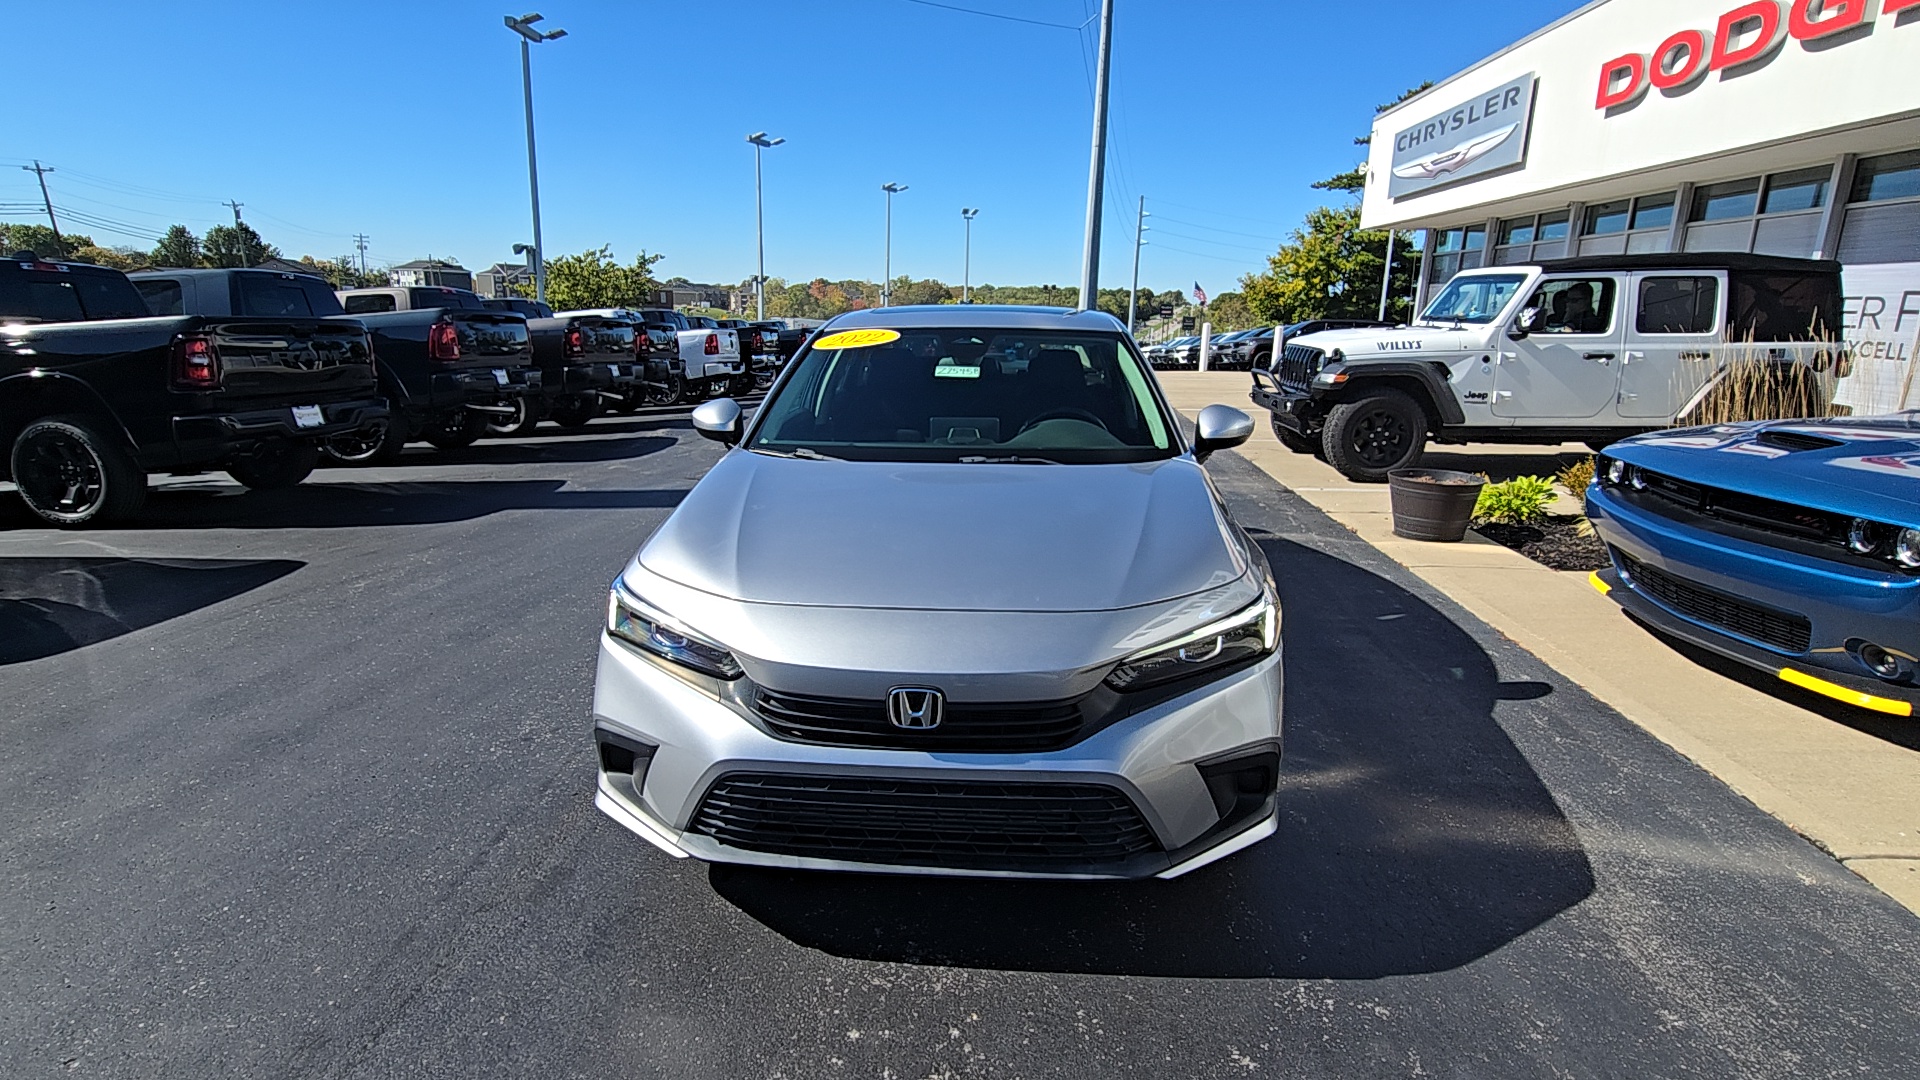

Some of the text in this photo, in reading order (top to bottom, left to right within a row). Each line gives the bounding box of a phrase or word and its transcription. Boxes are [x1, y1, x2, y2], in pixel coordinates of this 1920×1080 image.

[1595, 0, 1920, 110] DODG
[1396, 85, 1521, 152] CHRYSLER
[1841, 290, 1920, 332] ER F
[827, 332, 886, 346] 2022
[1376, 340, 1422, 351] WILLYS
[271, 350, 341, 369] RAM
[1844, 340, 1918, 361] XCELL
[1463, 391, 1488, 400] Jeep
